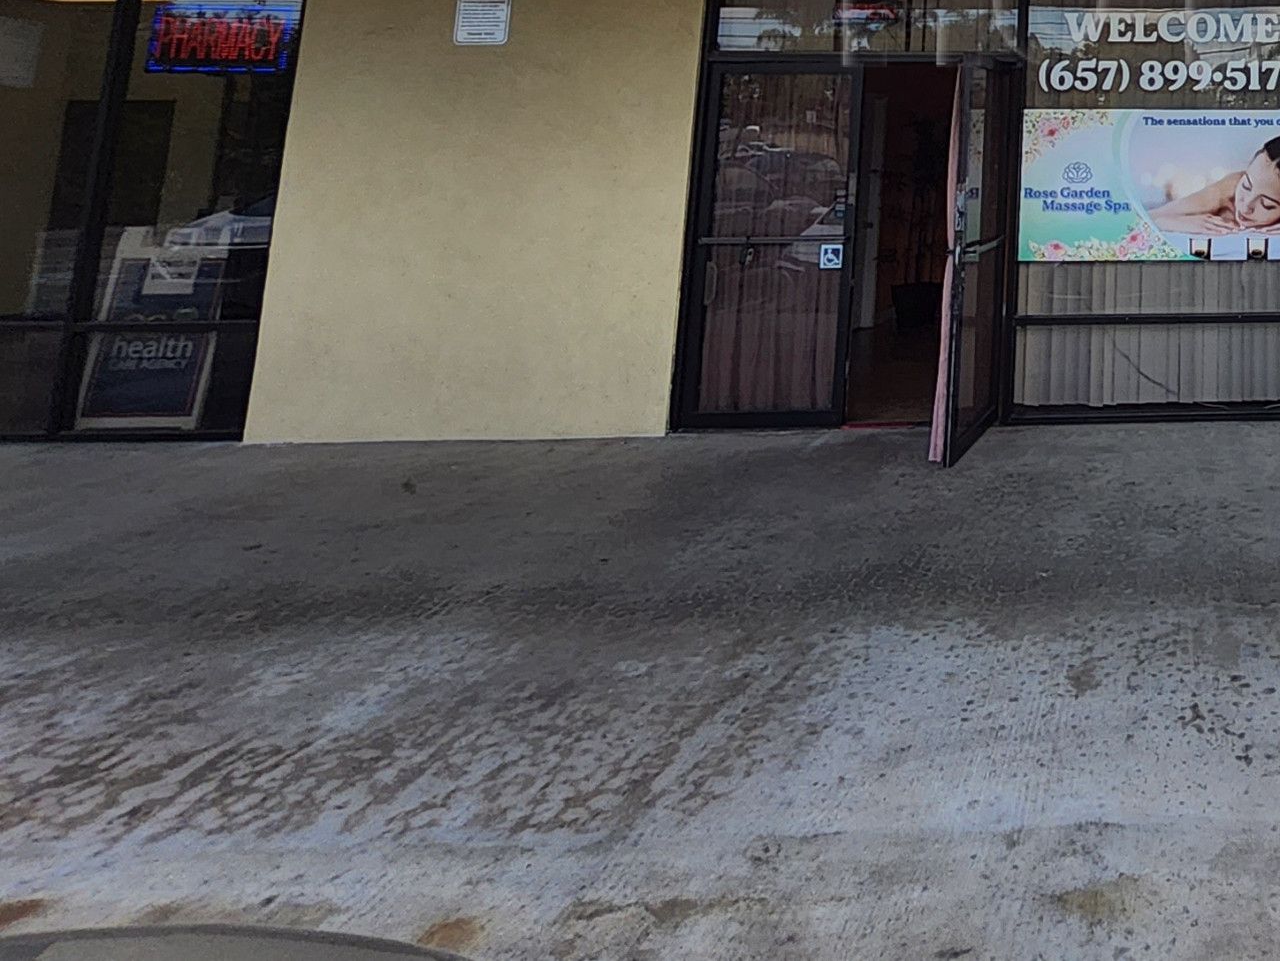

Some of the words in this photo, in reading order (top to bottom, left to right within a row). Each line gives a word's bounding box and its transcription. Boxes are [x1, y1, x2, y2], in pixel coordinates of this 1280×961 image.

[155, 17, 286, 61] PHARMACY
[1063, 11, 1280, 43] WELCOME
[1038, 58, 1130, 92] (657)
[1143, 116, 1164, 126] The
[1166, 116, 1226, 126] sensations
[1228, 116, 1252, 126] that
[1254, 118, 1274, 128] you
[1023, 187, 1058, 198] Rose
[1060, 187, 1111, 198] Garden
[1042, 200, 1102, 214] Massage
[1104, 200, 1131, 214] Spa
[112, 334, 193, 358] health
